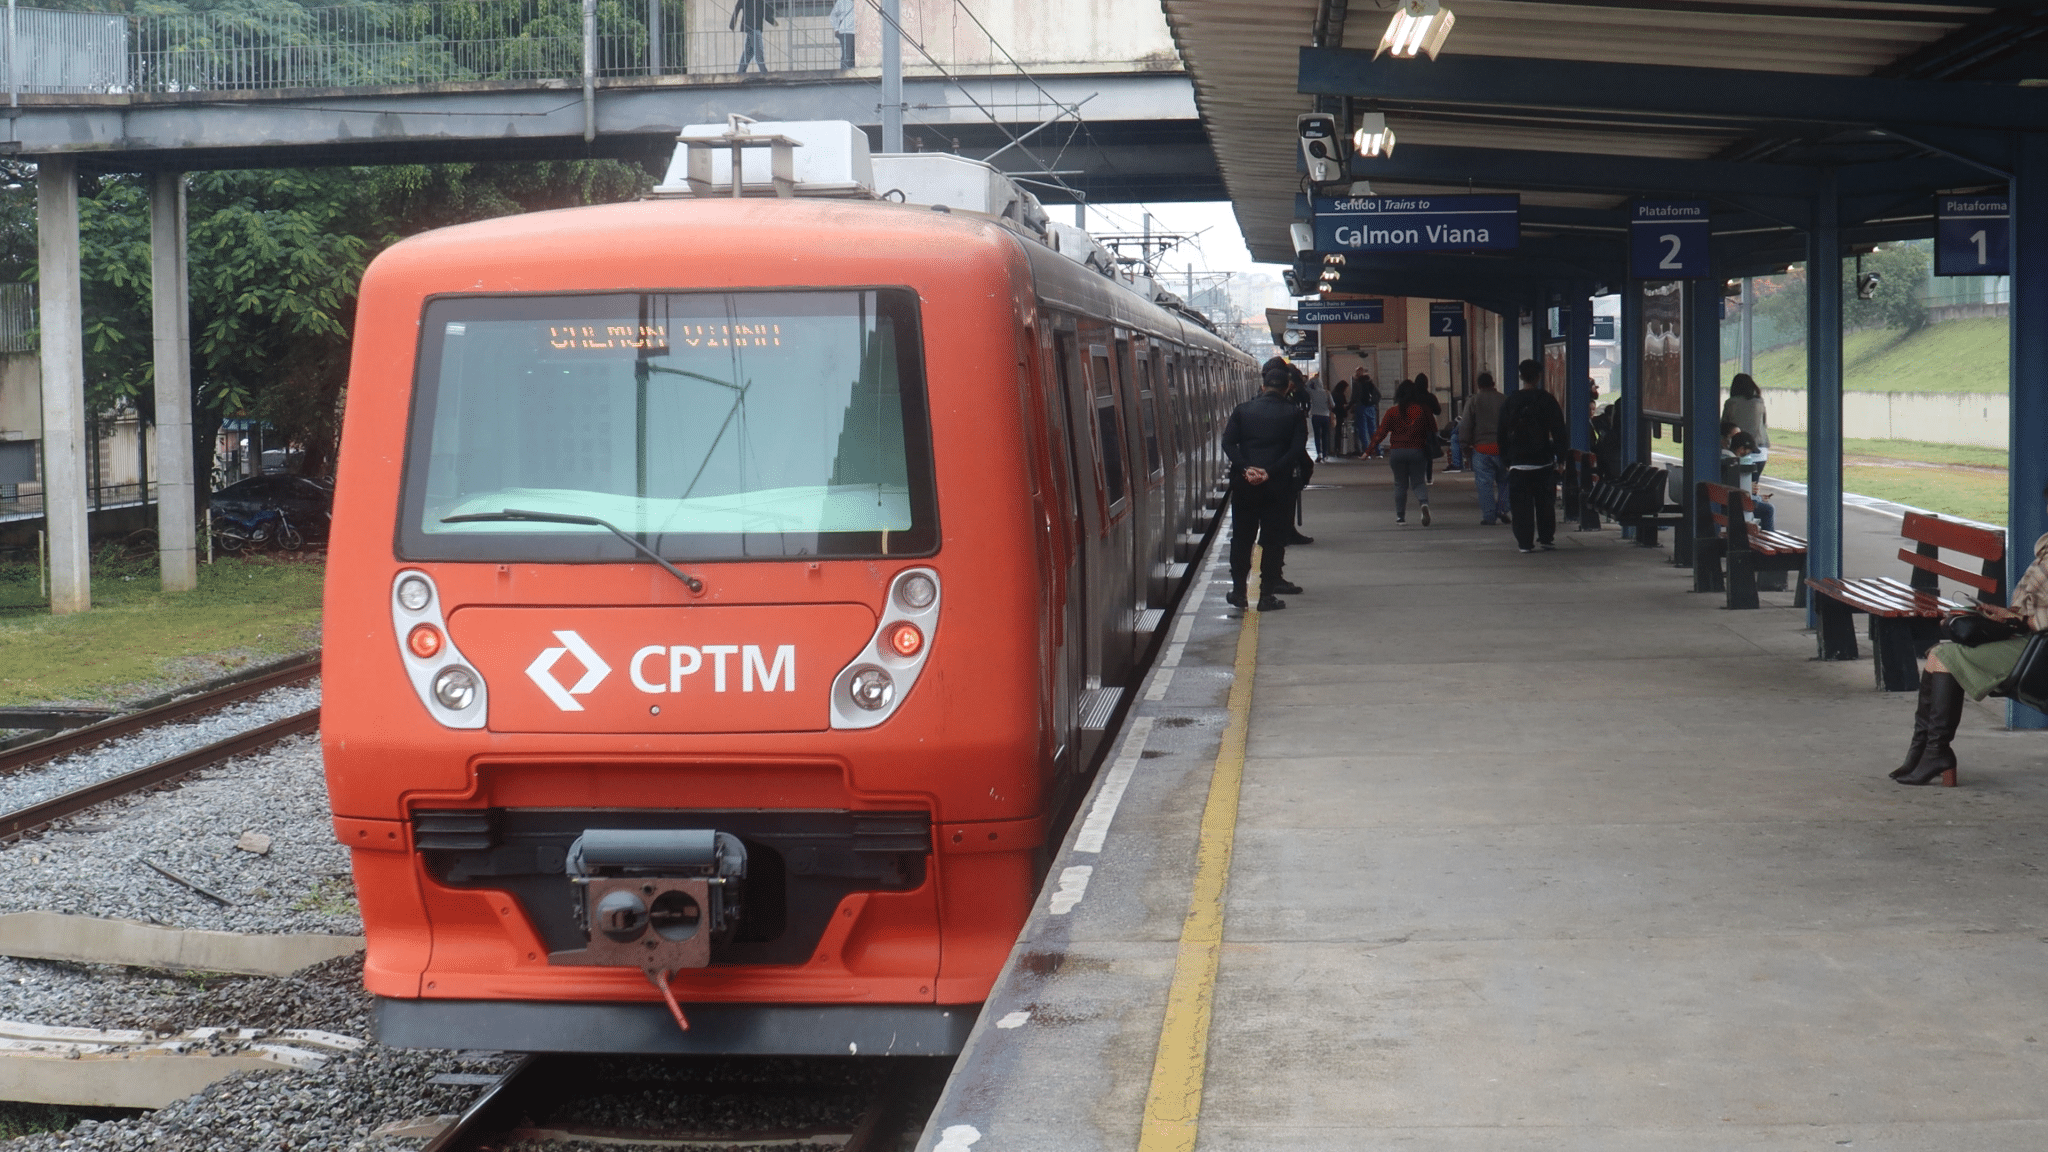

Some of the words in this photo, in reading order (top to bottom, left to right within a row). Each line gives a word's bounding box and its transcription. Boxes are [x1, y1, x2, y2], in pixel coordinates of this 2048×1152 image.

[1334, 199, 1376, 211] Sentido
[1385, 199, 1416, 210] Trains
[1418, 200, 1430, 209] to
[1639, 205, 1701, 216] Plataforma
[1947, 200, 2008, 212] Plataforma
[1334, 224, 1419, 246] Calmon
[1426, 224, 1489, 244] Viana
[1659, 233, 1683, 270] 2
[1969, 229, 1987, 265] 1
[1305, 312, 1341, 321] Calmon
[1343, 311, 1370, 320] Viana
[1442, 317, 1453, 333] 2
[629, 644, 796, 694] CPTM
